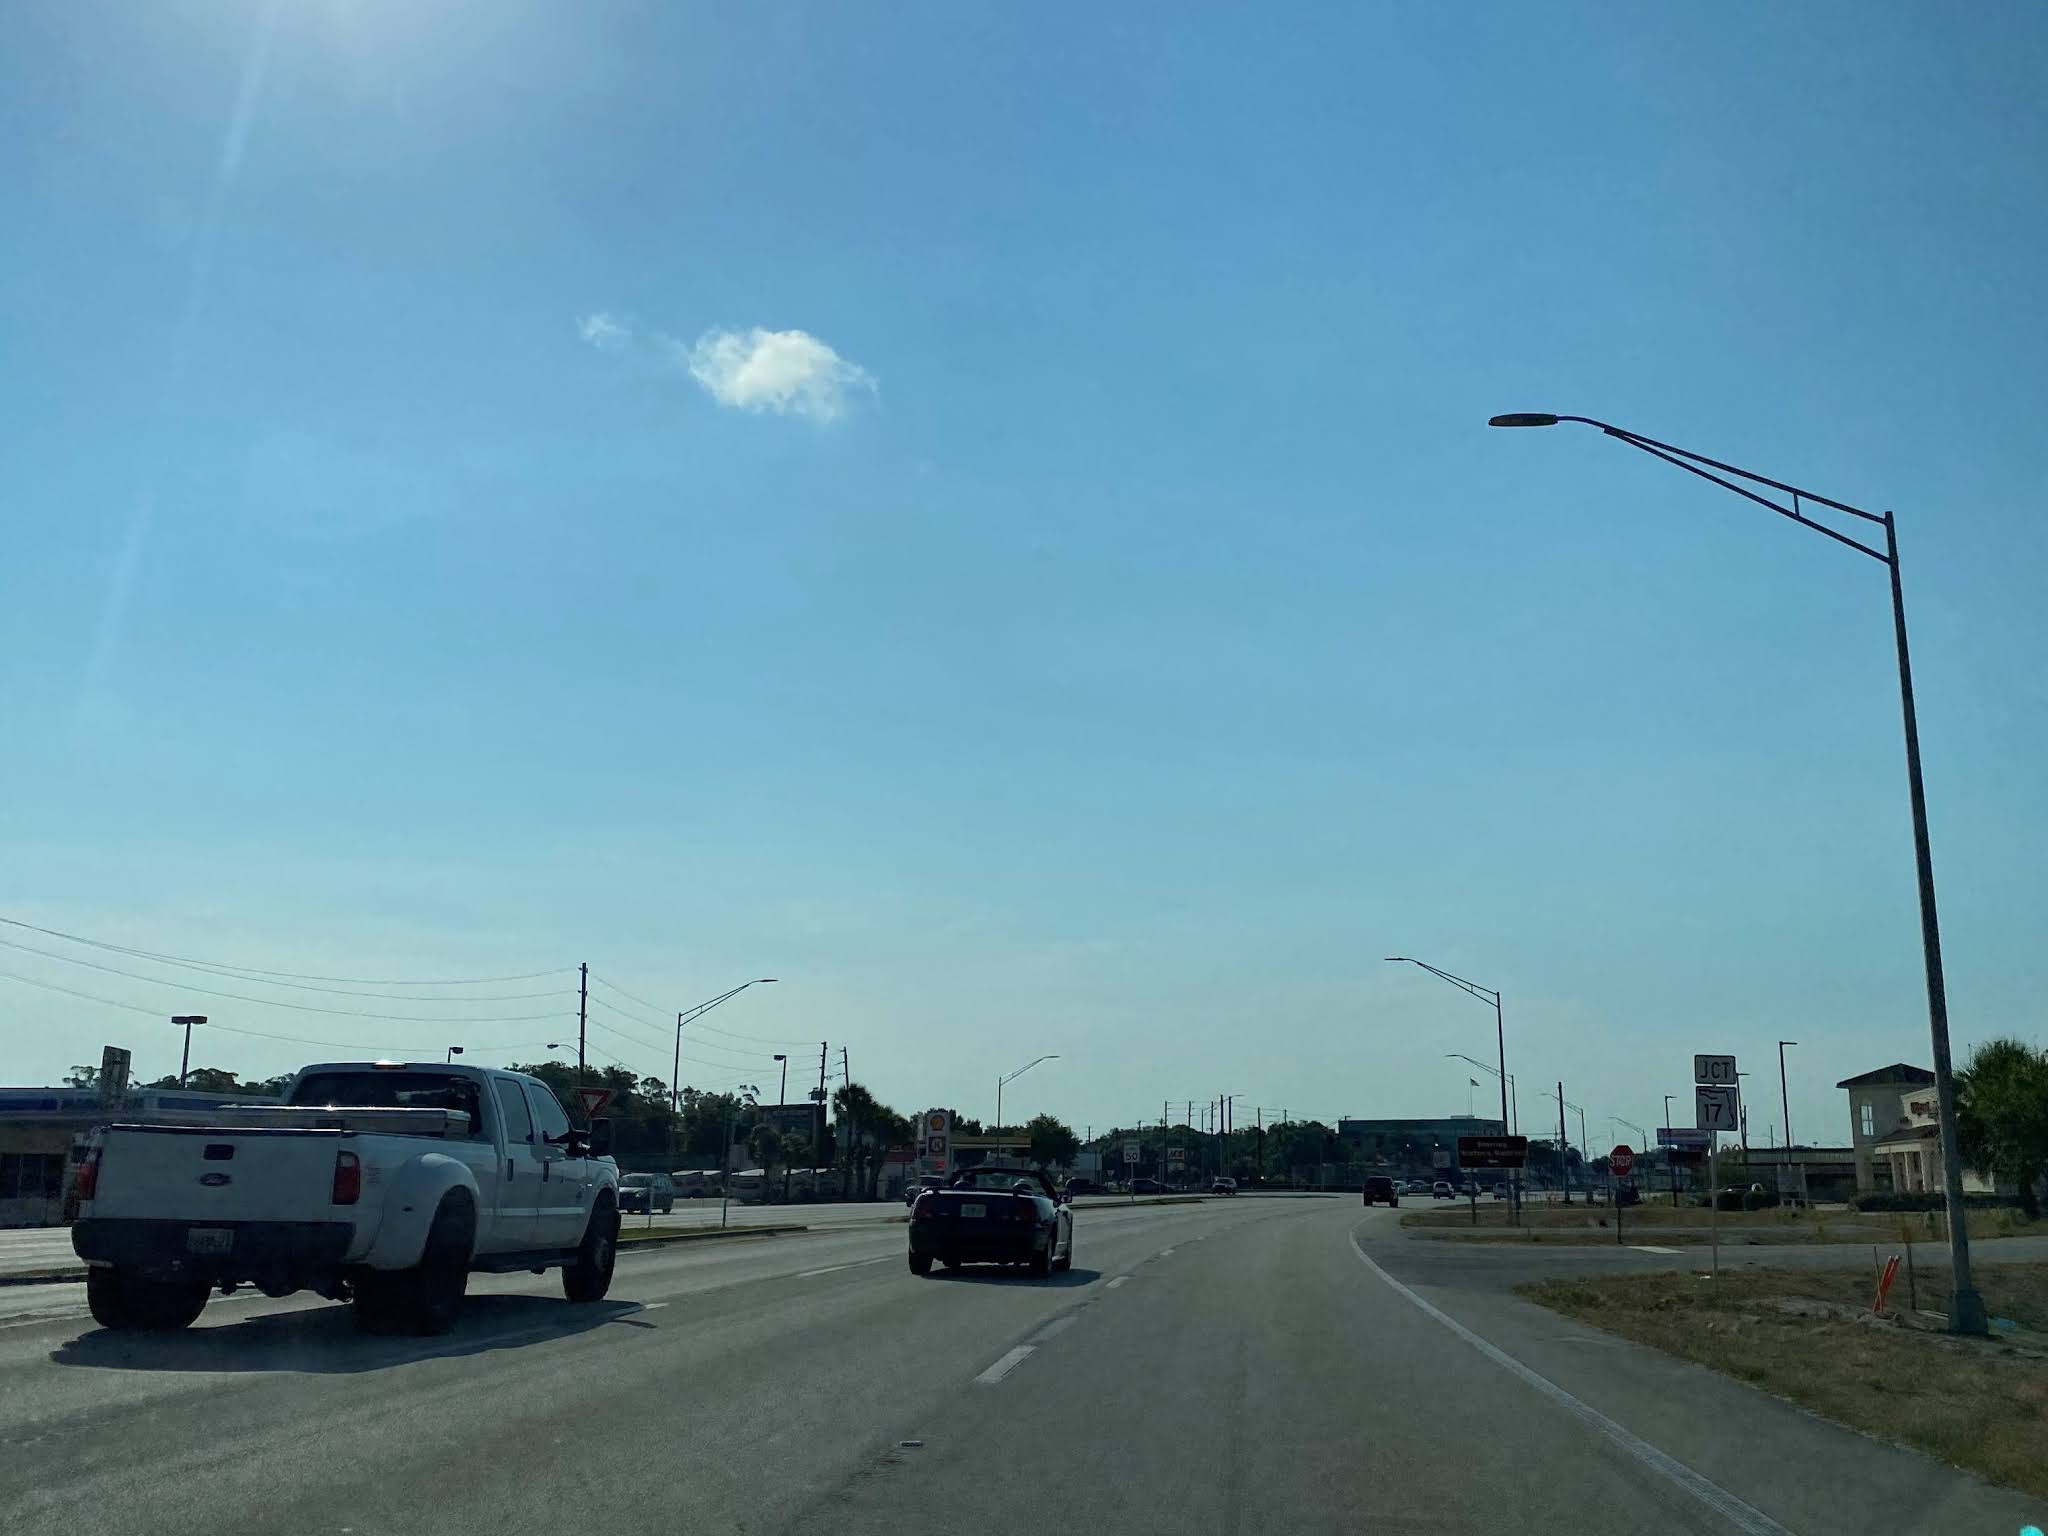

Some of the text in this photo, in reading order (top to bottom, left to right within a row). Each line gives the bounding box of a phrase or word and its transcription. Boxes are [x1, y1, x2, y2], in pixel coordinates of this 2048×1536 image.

[1700, 1061, 1730, 1079] JCT
[1704, 1104, 1722, 1122] 17
[1126, 1152, 1137, 1160] 50
[1609, 1155, 1632, 1167] STOP
